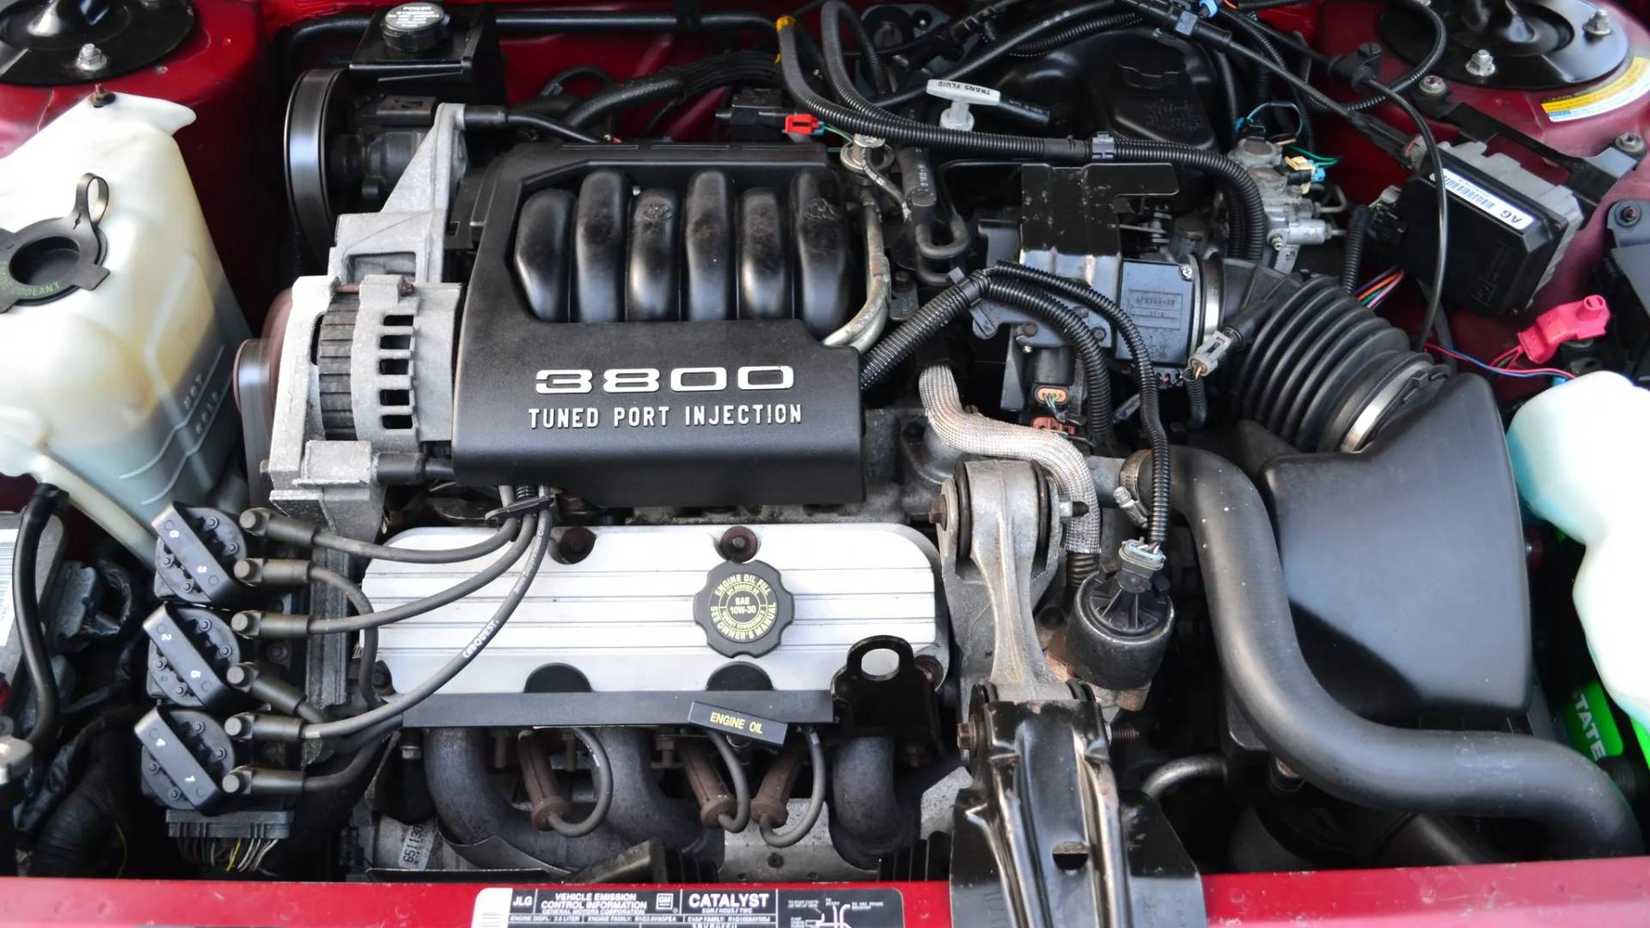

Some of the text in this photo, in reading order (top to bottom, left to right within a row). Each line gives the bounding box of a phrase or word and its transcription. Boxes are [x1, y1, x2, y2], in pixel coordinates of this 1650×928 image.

[1500, 210, 1523, 223] AG
[535, 365, 794, 394] 3800
[528, 404, 801, 429] TUNED PORT INJECTION
[714, 574, 741, 596] ENGINE
[743, 573, 755, 584] OIL
[757, 579, 771, 596] FILL
[735, 597, 750, 605] SAE
[729, 605, 757, 614] 10W-30
[710, 606, 721, 624] SEE
[716, 622, 755, 640] OWNER'S
[755, 602, 776, 636] MANUAL
[709, 712, 763, 735] ENGINE OIL
[513, 895, 533, 906] JLG
[555, 892, 637, 901] VEHICLE EMISSION
[689, 893, 769, 908] CATALYST
[541, 900, 647, 910] CONTROL INFORMATION
